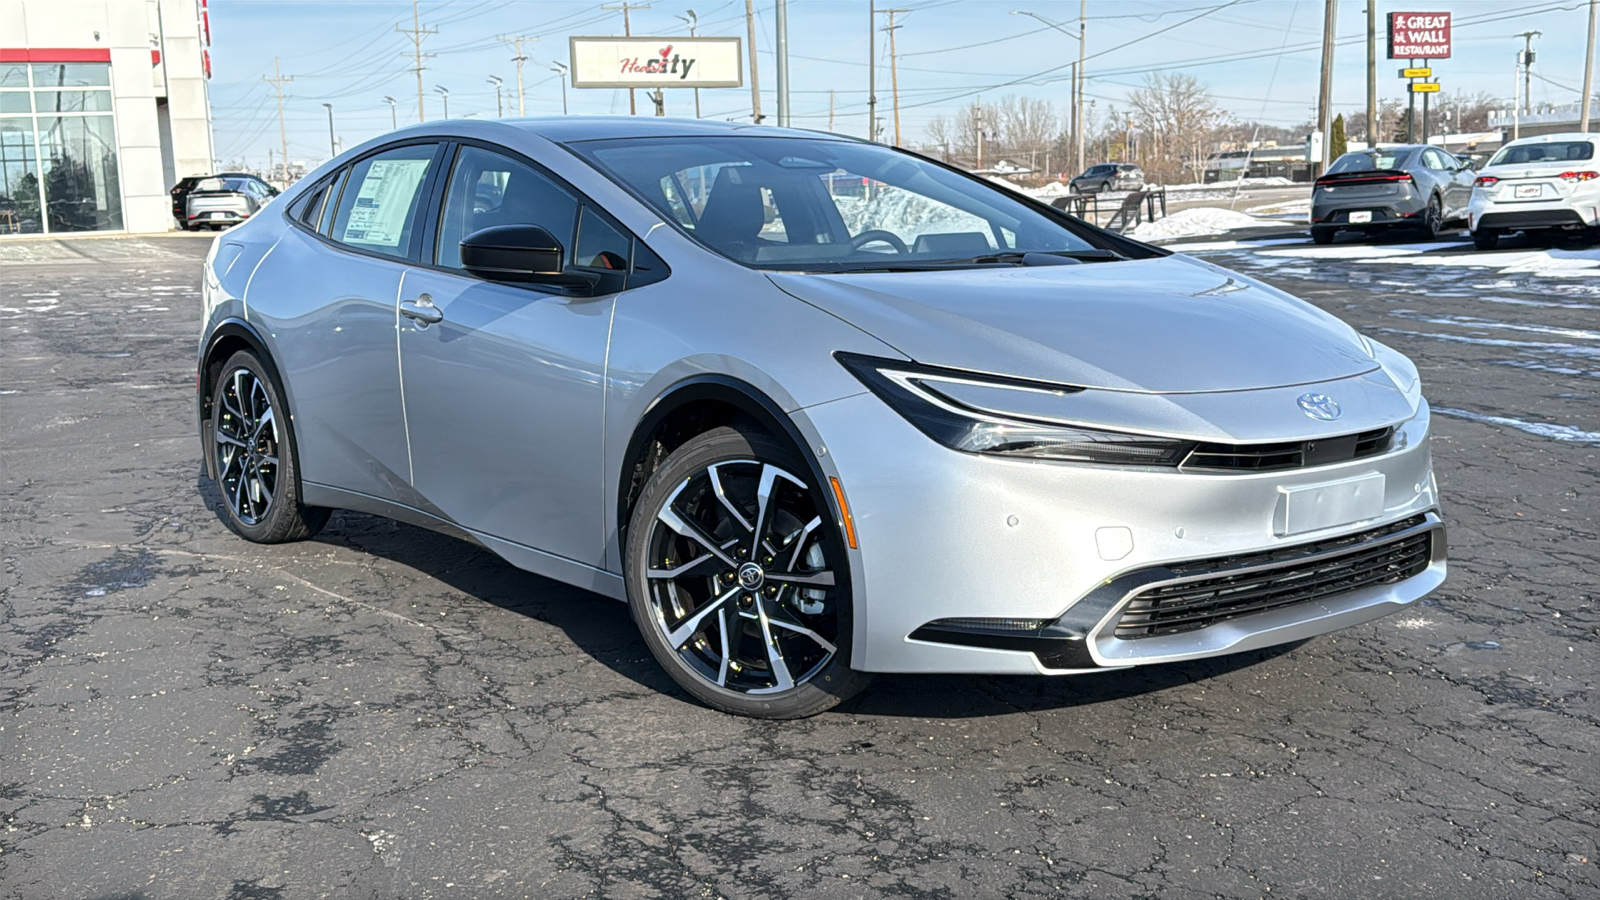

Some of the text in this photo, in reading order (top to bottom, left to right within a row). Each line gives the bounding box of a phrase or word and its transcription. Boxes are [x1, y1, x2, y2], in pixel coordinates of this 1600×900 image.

[1407, 16, 1448, 29] GREAT
[1408, 31, 1446, 43] WALL
[1394, 45, 1449, 55] RESTAURANT
[620, 57, 674, 74] Heart
